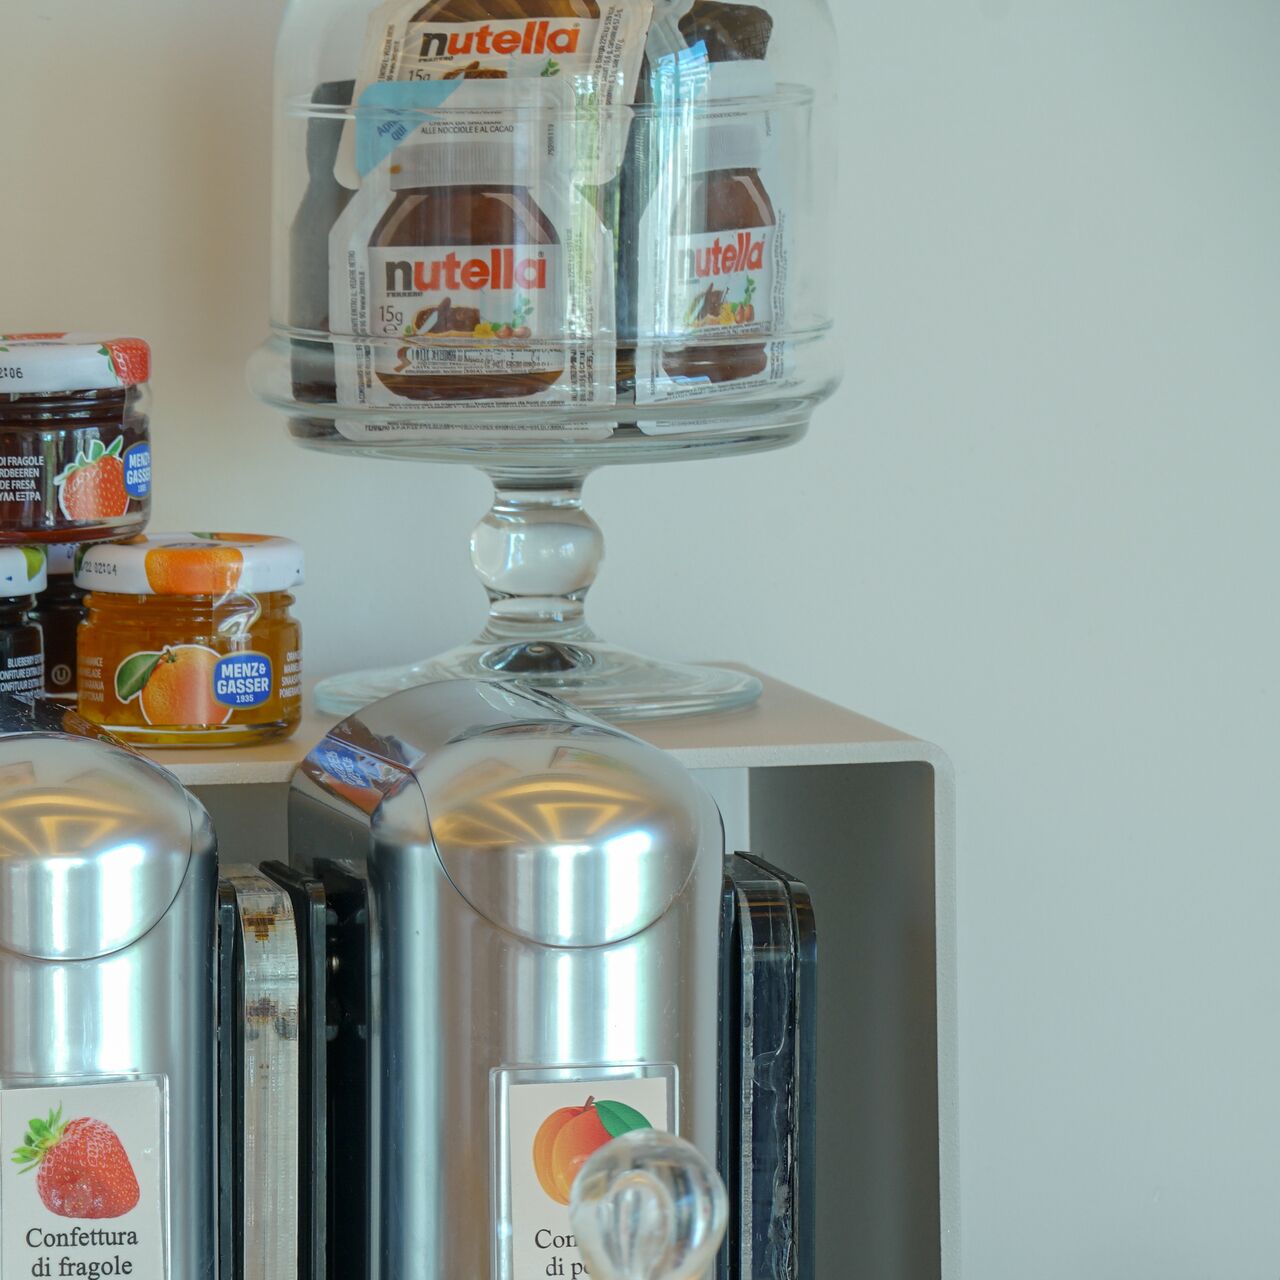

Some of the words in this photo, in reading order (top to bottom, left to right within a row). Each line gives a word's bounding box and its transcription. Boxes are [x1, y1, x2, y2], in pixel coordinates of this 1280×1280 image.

[419, 21, 580, 58] nutella
[385, 248, 546, 291] nutella
[378, 305, 403, 325] 15g
[7, 455, 45, 467] FRAGOLE
[0, 479, 11, 490] DE
[11, 479, 37, 490] FRESA
[221, 662, 266, 678] MENZ&
[217, 677, 270, 694] GASSER
[236, 694, 254, 703] 1935
[26, 1227, 139, 1248] Confettura
[31, 1257, 51, 1277] di
[58, 1255, 133, 1280] fragole
[545, 1256, 565, 1276] di
